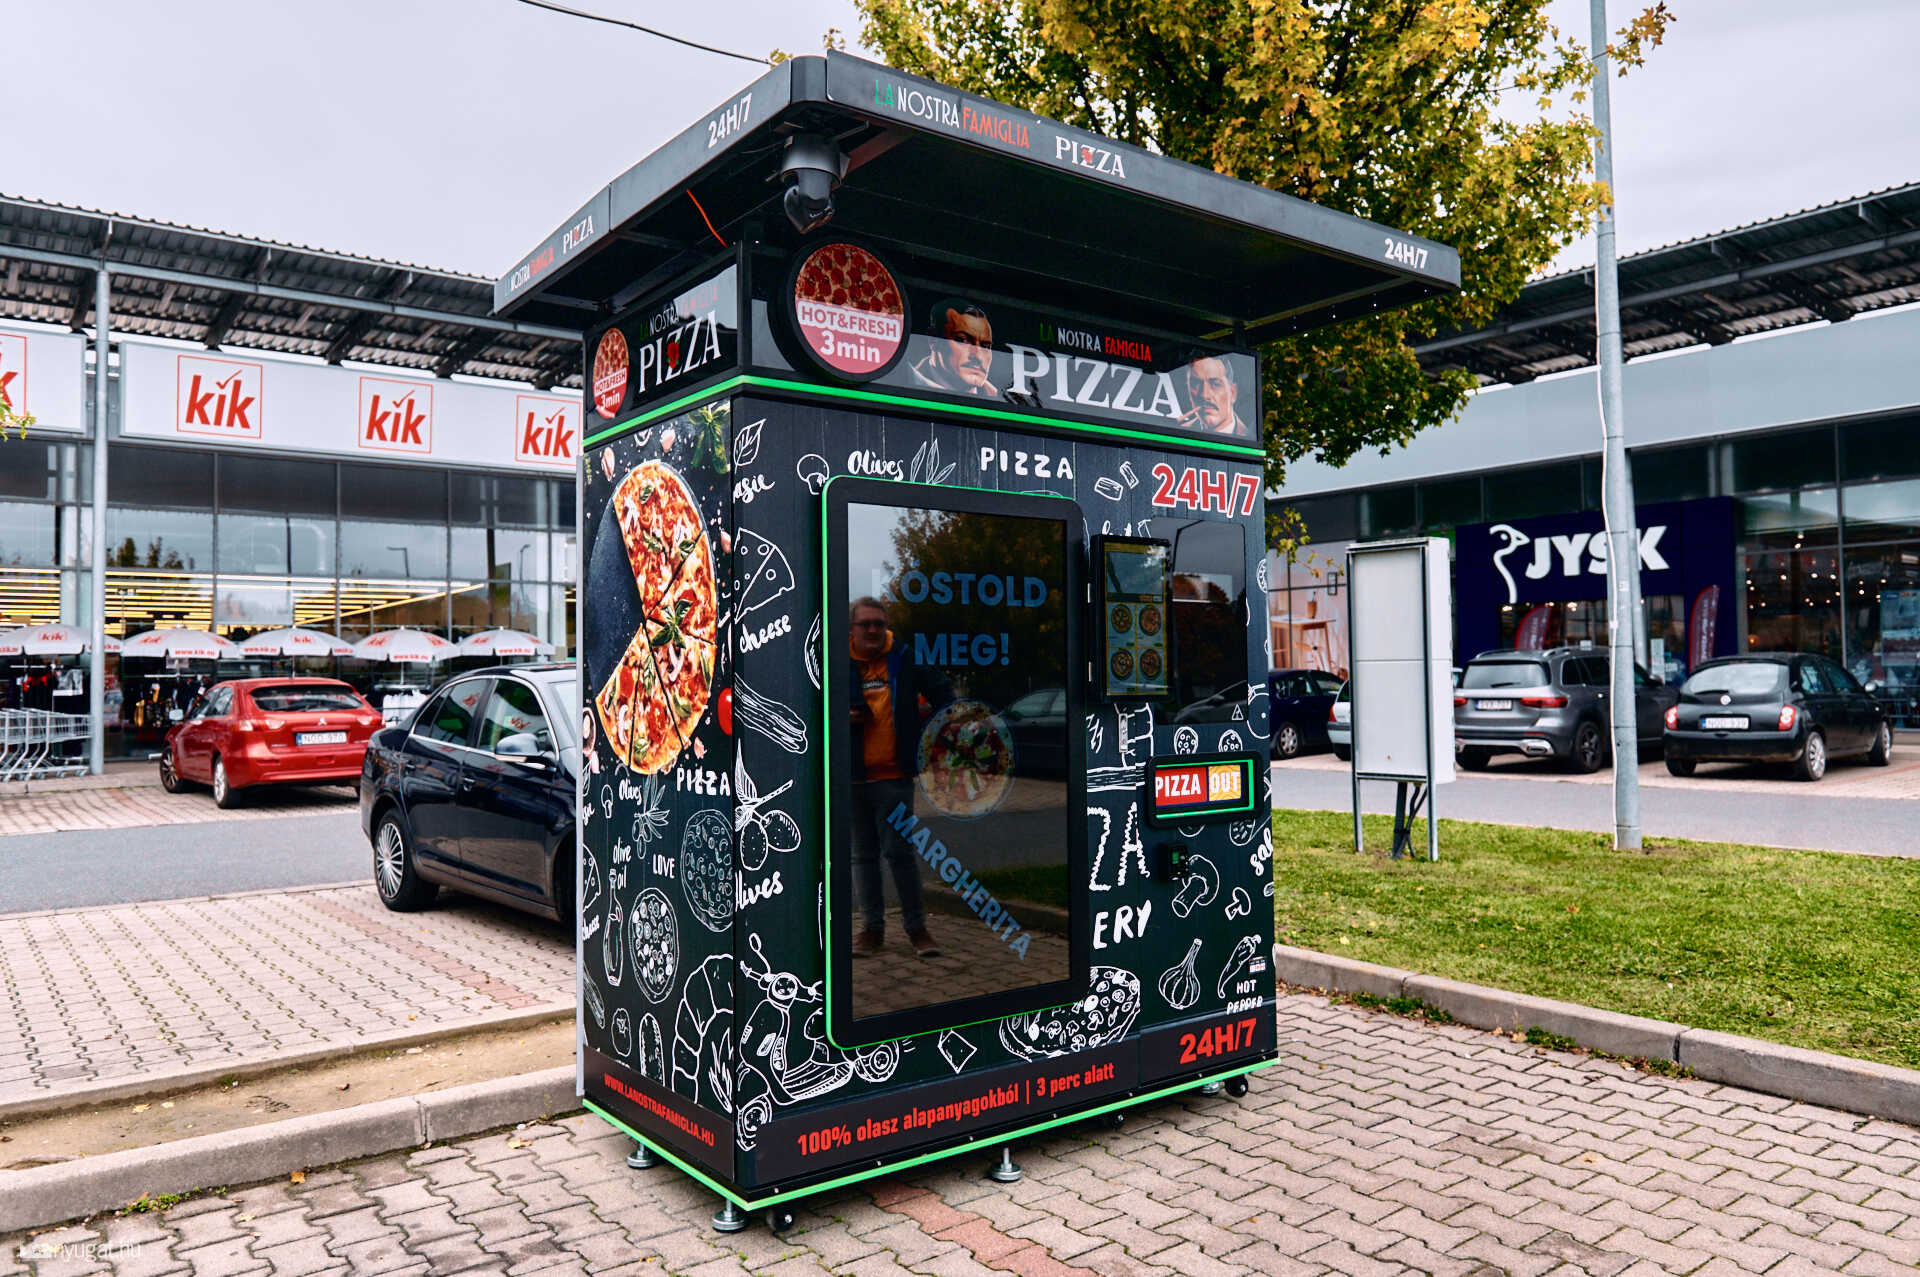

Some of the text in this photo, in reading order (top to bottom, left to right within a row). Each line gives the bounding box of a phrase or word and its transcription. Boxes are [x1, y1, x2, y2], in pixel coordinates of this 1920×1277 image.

[707, 92, 753, 149] 24H/7
[875, 79, 1031, 149] LA NOSTRA FAMIGLIA
[1055, 135, 1126, 179] PIZZA
[562, 215, 595, 256] PIZZA
[1383, 237, 1429, 269] 24H/7
[800, 304, 898, 338] HOT&FRESH
[638, 310, 722, 394] PIZZA
[1057, 327, 1102, 353] NOSTRA
[1104, 336, 1153, 363] FAMIGLIA
[185, 369, 256, 430] kik
[1004, 342, 1190, 421] PIZZA
[365, 389, 427, 445] kik
[521, 406, 575, 459] kik
[847, 449, 905, 482] Olives
[980, 446, 1074, 480] PIZZA
[1151, 462, 1261, 519] 24H/7
[739, 614, 792, 654] cheese
[913, 632, 1011, 666] MEG!
[675, 766, 731, 797] PIZZA
[1154, 770, 1240, 798] PIZZA OUT
[652, 853, 676, 880] LOVE
[885, 800, 1032, 961] MARGHERITA
[1236, 979, 1258, 995] HOT
[1179, 1017, 1257, 1066] 24H/7
[797, 1124, 852, 1157] 100%
[856, 1115, 900, 1142] olasz
[903, 1082, 1019, 1131] alapanyagokból
[1036, 1076, 1047, 1097] 3
[1050, 1070, 1081, 1098] perc
[1084, 1061, 1116, 1087] alatt
